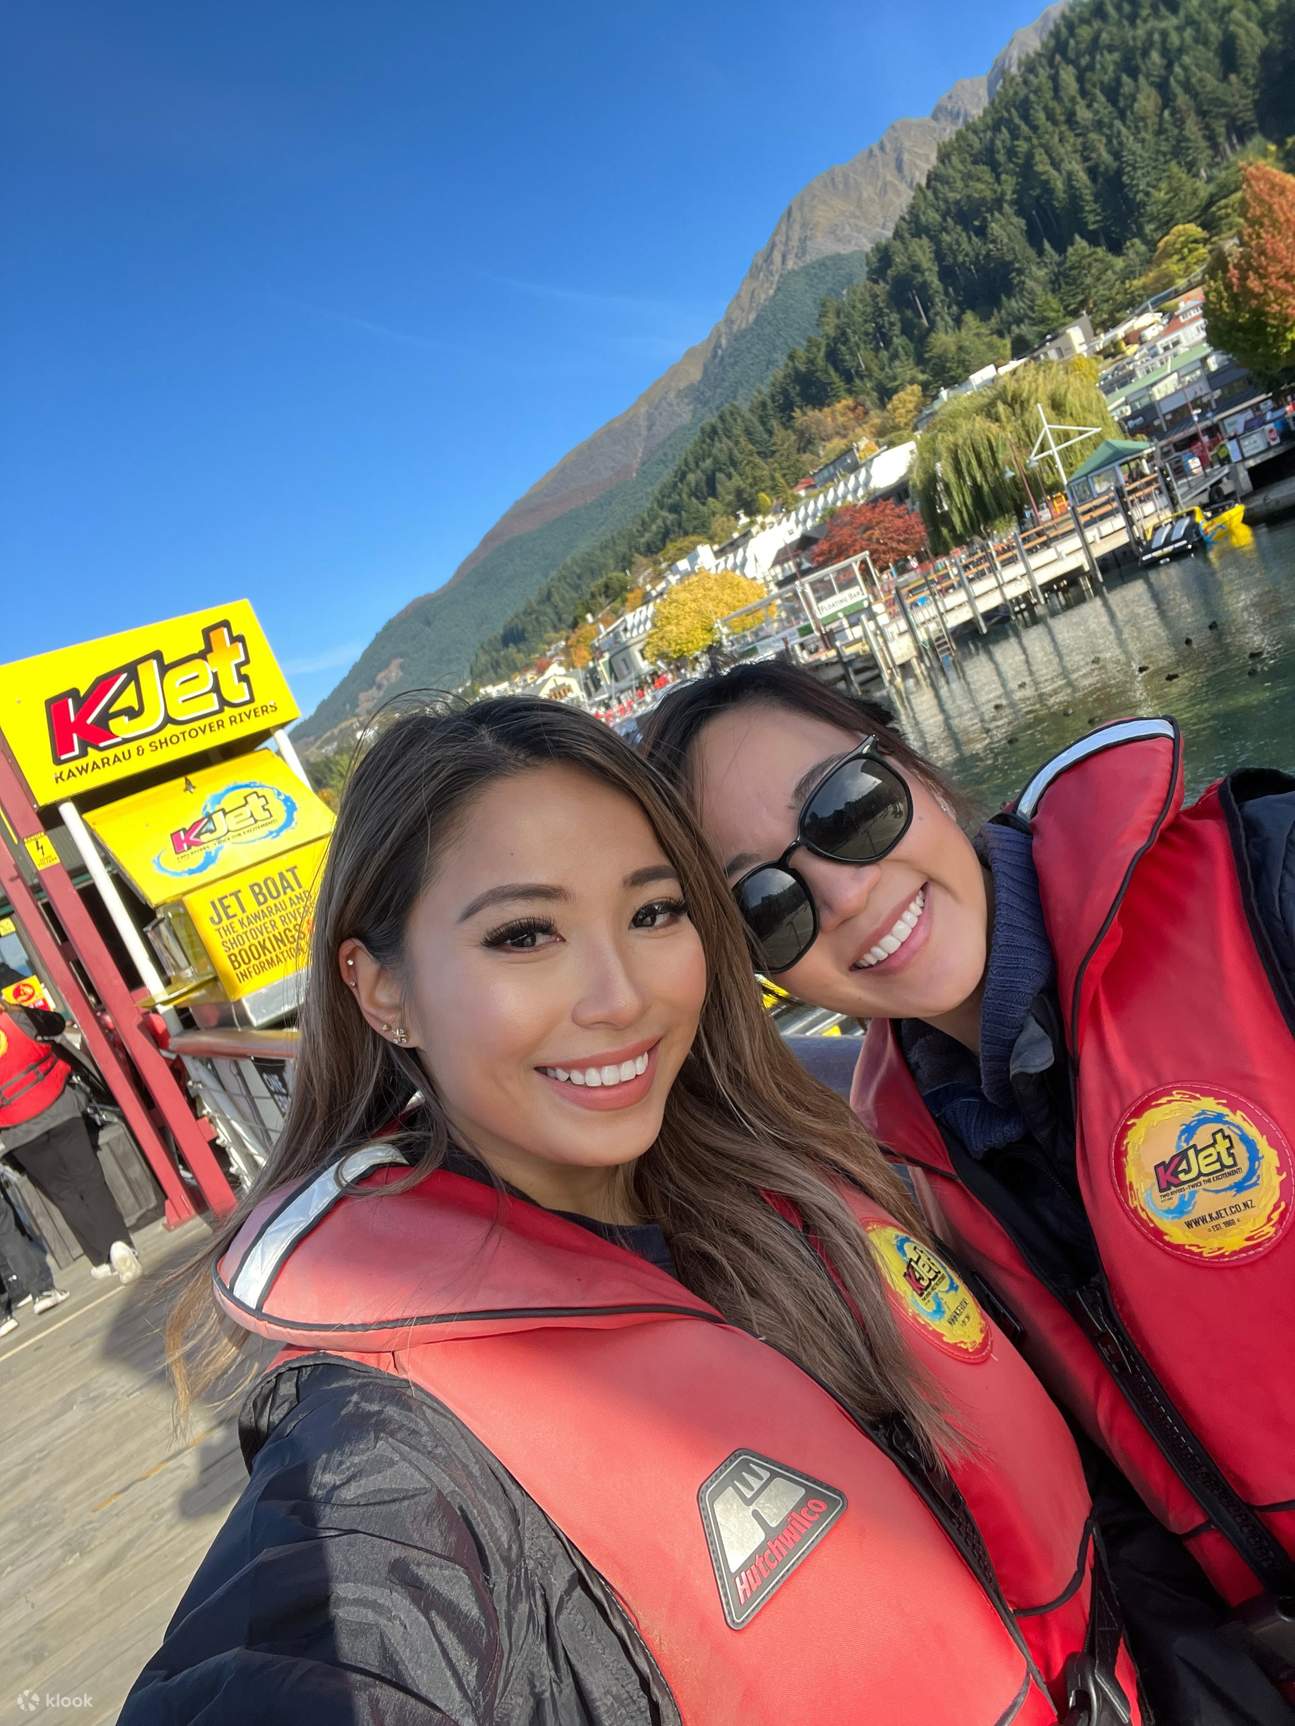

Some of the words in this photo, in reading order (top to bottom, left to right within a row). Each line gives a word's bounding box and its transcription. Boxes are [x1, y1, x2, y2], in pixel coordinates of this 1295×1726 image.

[45, 619, 255, 766] KJet
[54, 746, 132, 784] KAWARAU
[149, 719, 225, 752] SHOTOVER
[229, 702, 279, 727] RIVERS
[170, 791, 273, 856] KJet
[209, 889, 247, 926] JET
[248, 865, 303, 907] BOAT
[216, 920, 239, 940] THE
[238, 900, 288, 930] KAWARAU
[221, 919, 278, 954] SHOTOVER
[227, 923, 306, 972] BOOKINGS
[1154, 1128, 1238, 1193] KJet
[735, 1498, 829, 1607] Hutchwilco
